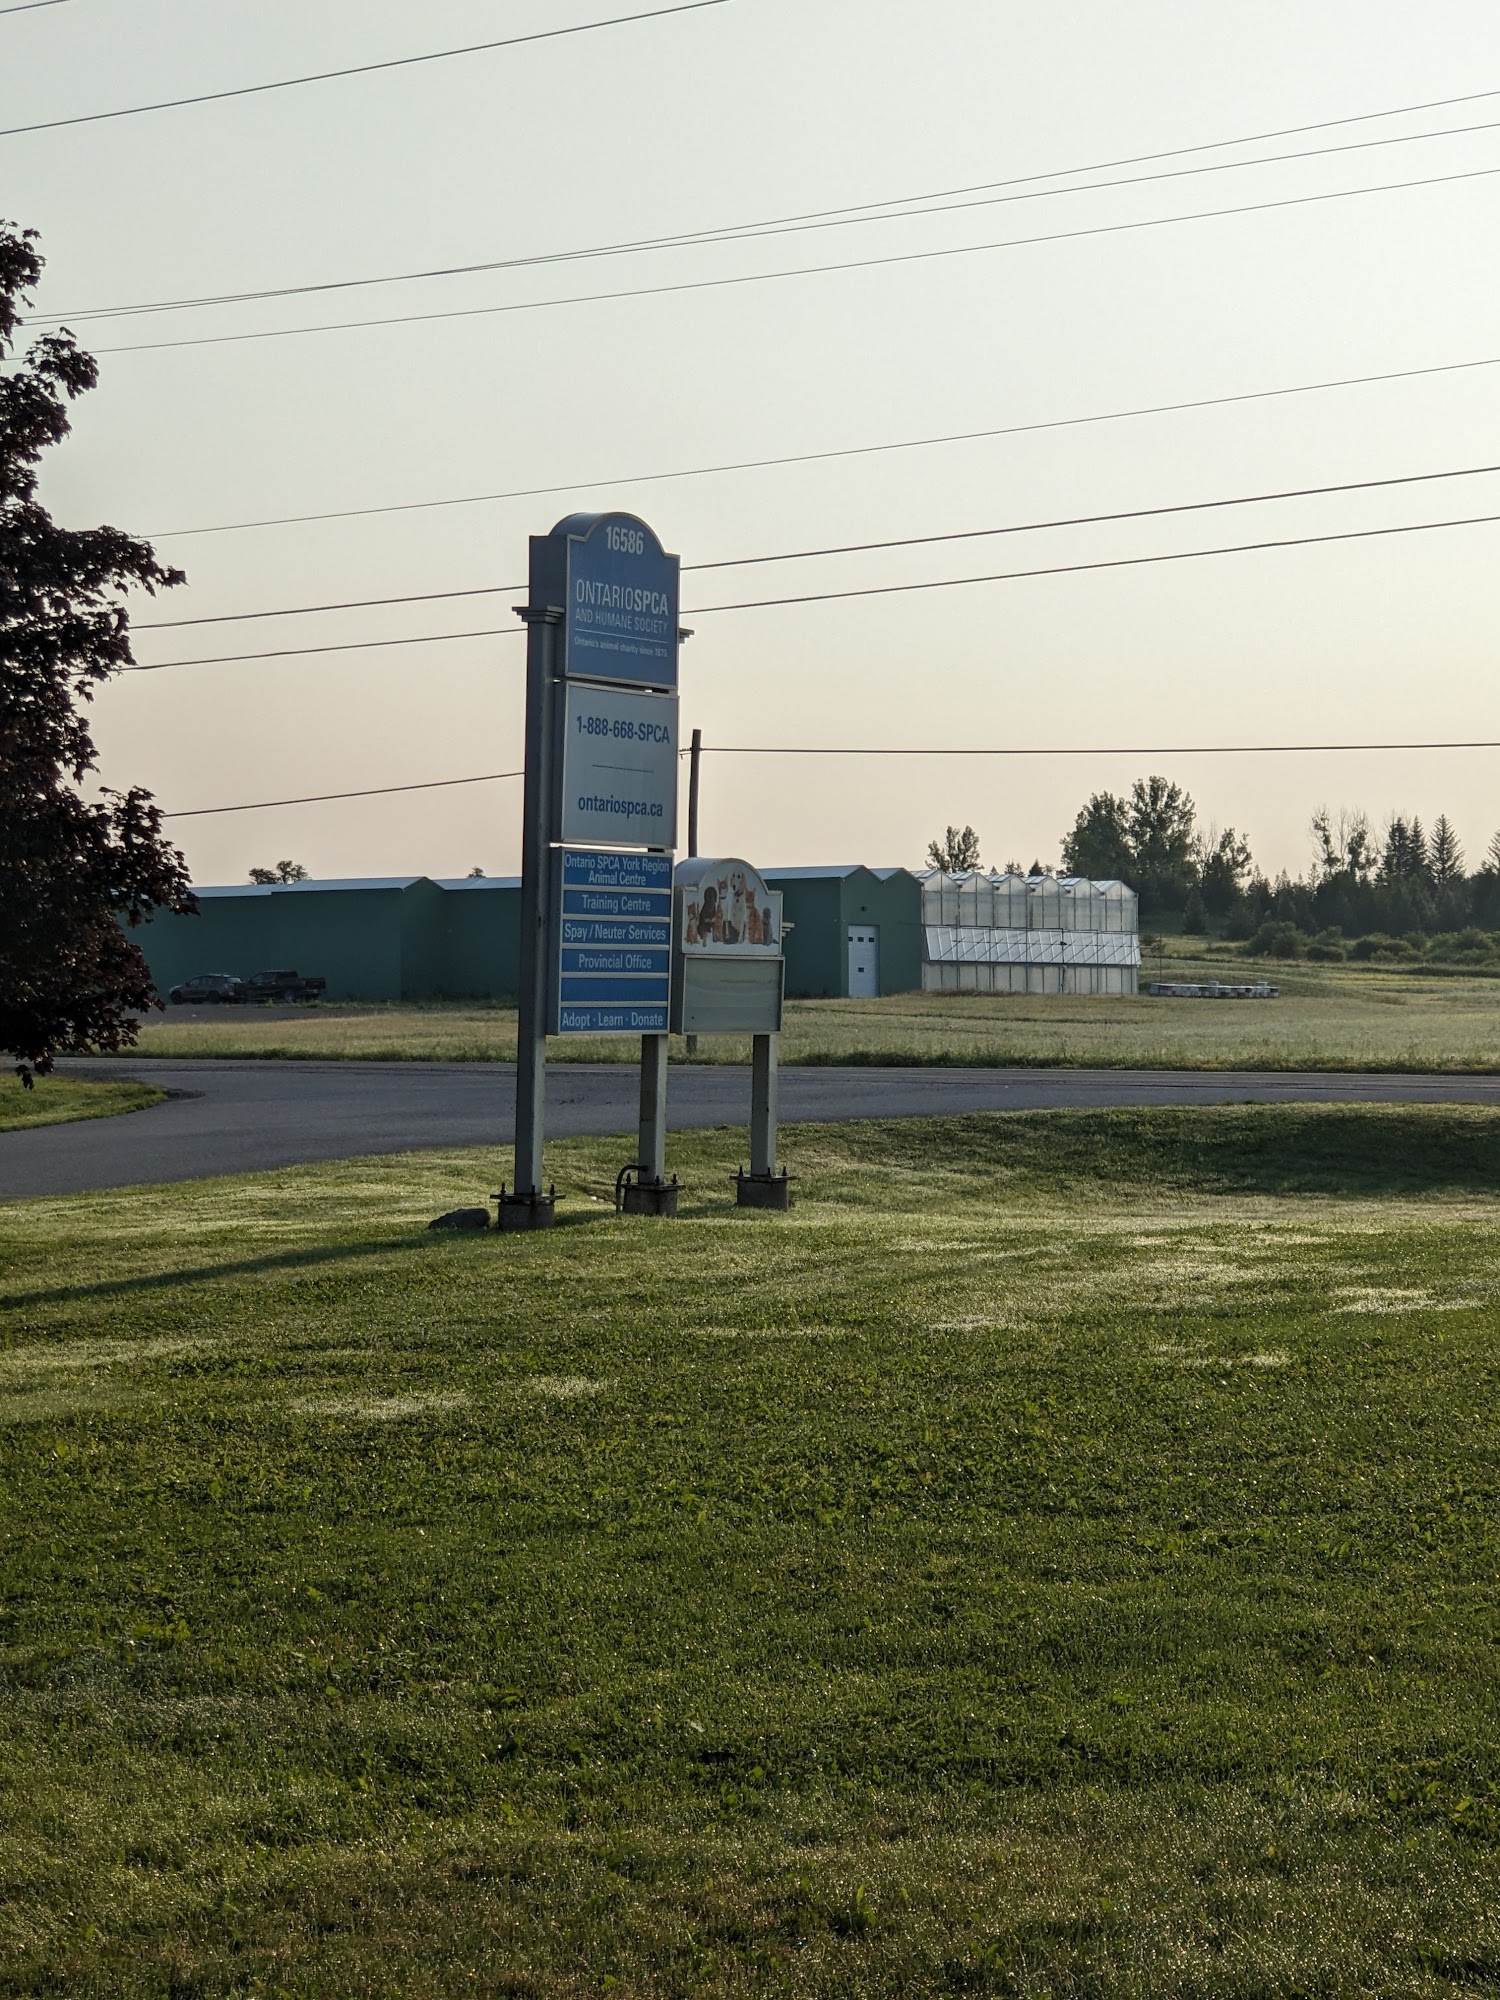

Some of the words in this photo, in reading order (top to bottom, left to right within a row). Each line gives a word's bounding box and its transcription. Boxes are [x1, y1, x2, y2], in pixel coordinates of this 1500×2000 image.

[606, 526, 644, 555] 16586
[576, 579, 669, 616] ONTARIOSPCA
[575, 608, 592, 623] AND
[595, 613, 632, 628] HUMANE
[635, 619, 668, 634] SOCIETY
[576, 715, 670, 744] 1-888-668-SPCA
[578, 795, 663, 818] ontariospca.ca
[565, 854, 595, 868] Ontario
[597, 856, 620, 870] SPCA
[622, 857, 640, 871] York
[642, 858, 669, 875] Region
[588, 870, 618, 884] Animal
[620, 874, 646, 886] Centre
[582, 894, 618, 913] Training
[621, 897, 651, 911] Centre
[565, 923, 587, 941] Spay
[589, 925, 594, 938] /
[595, 926, 626, 939] Neuter
[628, 925, 666, 940] Services
[579, 954, 623, 968] Provincial
[626, 955, 652, 969] Office
[562, 1012, 590, 1029] Adopt
[598, 1012, 623, 1026] Learn
[631, 1012, 663, 1026] Donate
